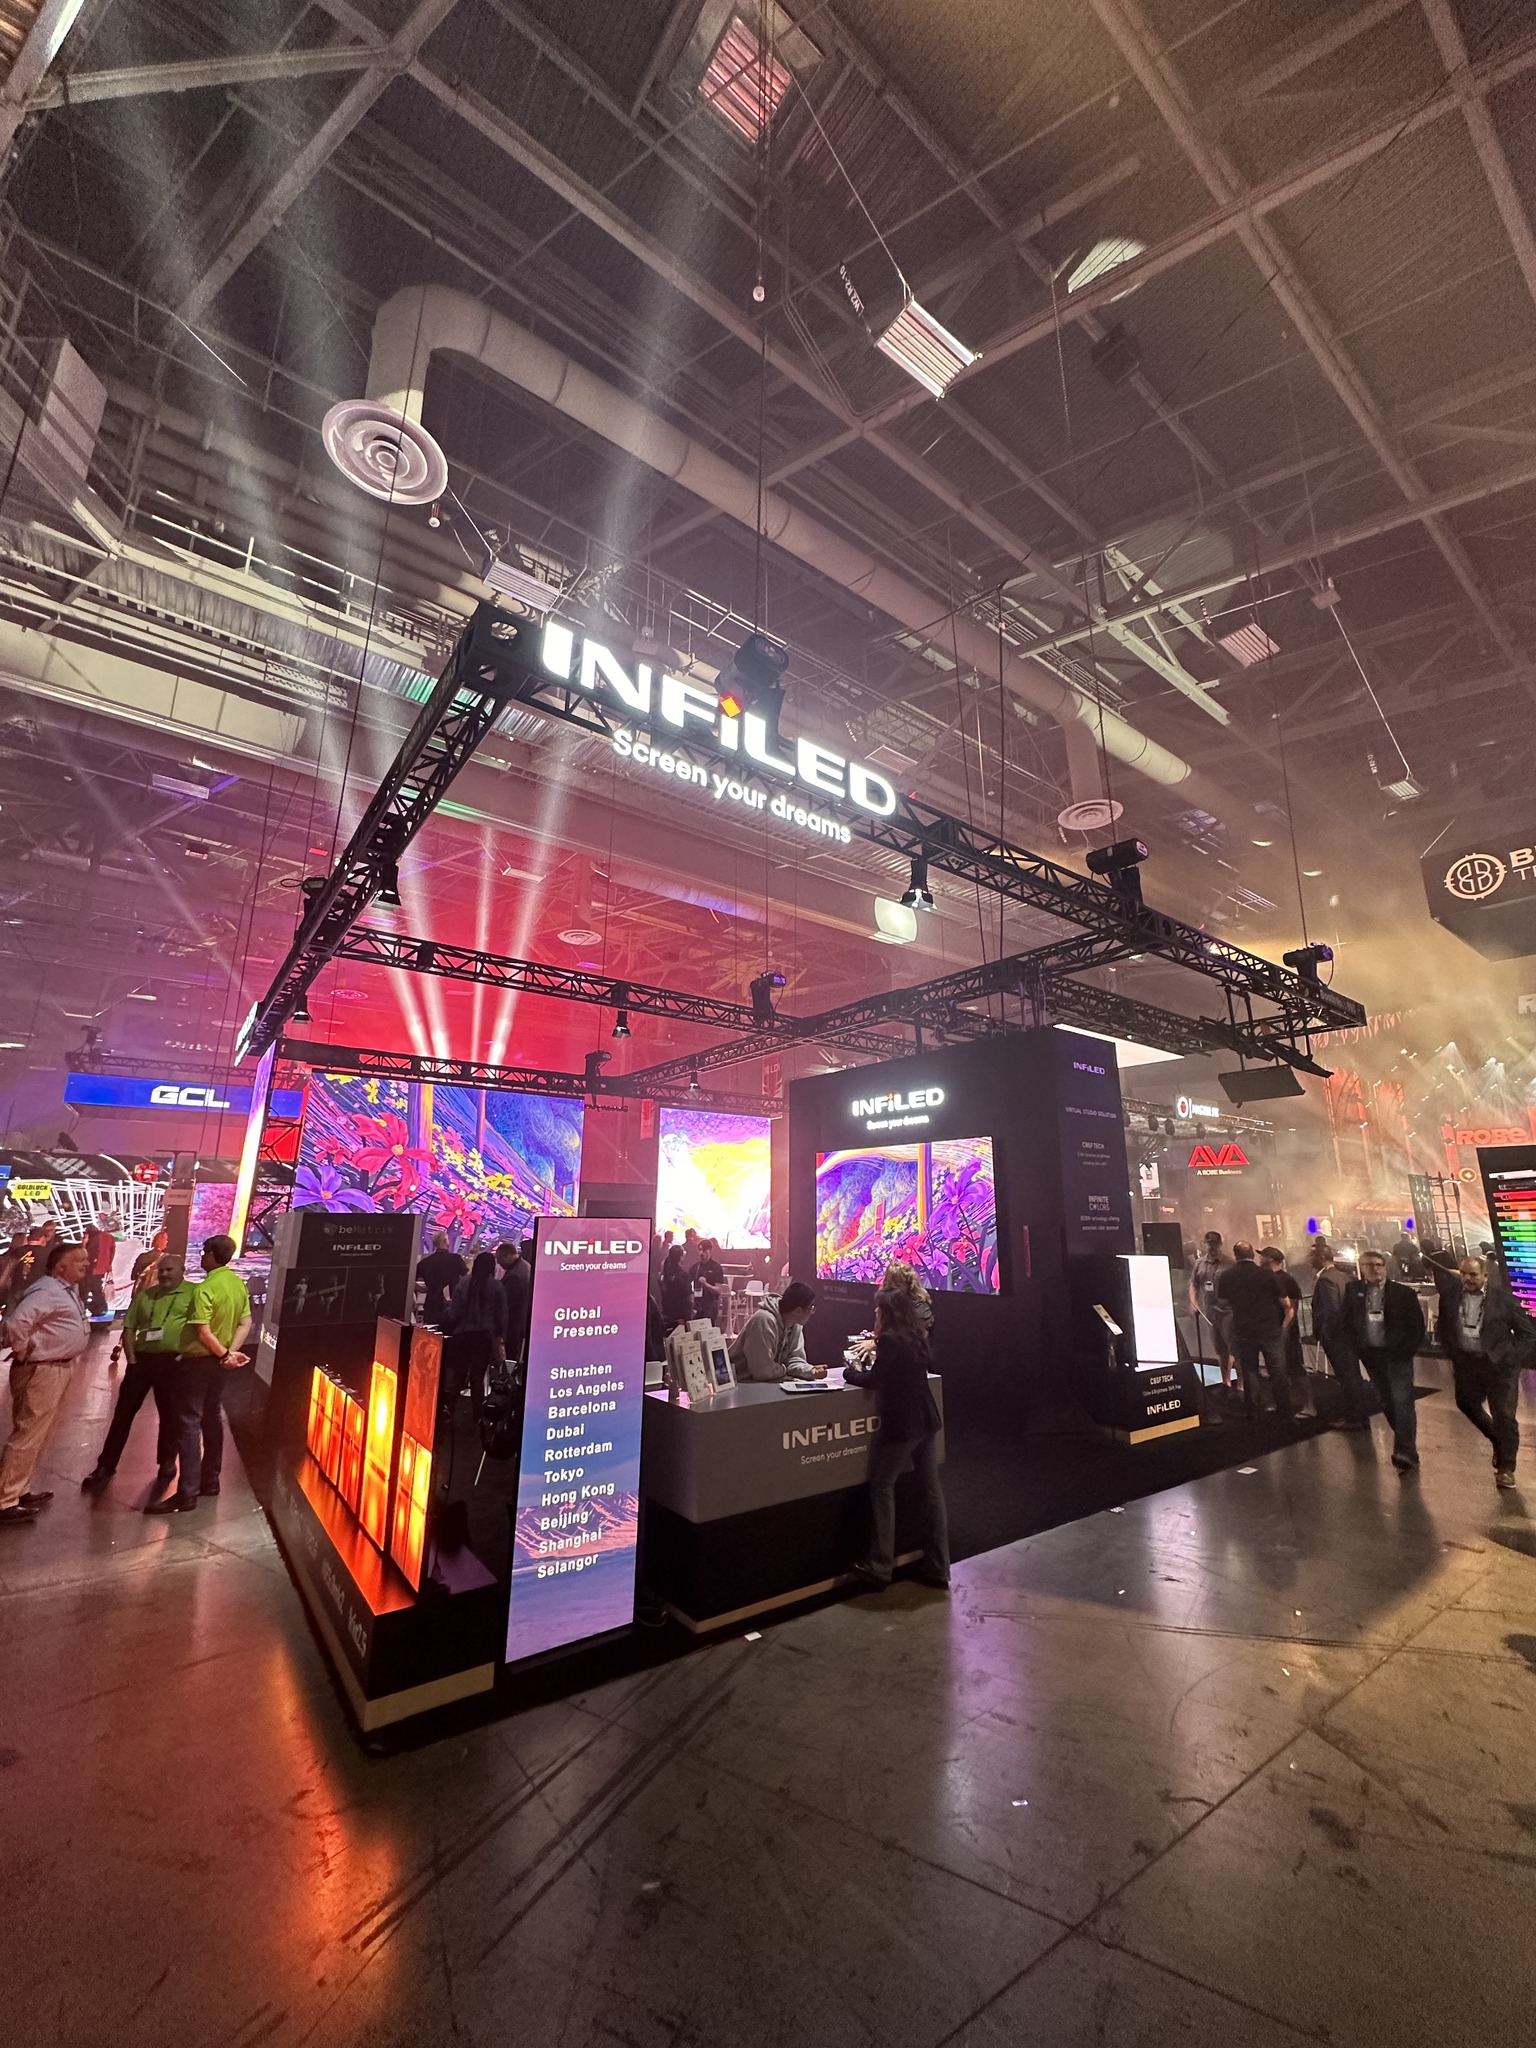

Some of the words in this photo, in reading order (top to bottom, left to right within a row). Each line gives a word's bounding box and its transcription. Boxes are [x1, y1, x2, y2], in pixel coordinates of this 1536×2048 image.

[612, 730, 708, 788] Screen
[711, 772, 768, 811] your
[771, 793, 852, 844] dreams
[150, 1085, 231, 1109] GCL
[1187, 1143, 1250, 1168] AVA
[560, 1262, 585, 1271] Screen
[585, 1263, 601, 1272] your
[602, 1261, 627, 1270] dreams
[554, 1306, 601, 1321] Global
[553, 1323, 619, 1339] Presence
[550, 1363, 613, 1380] Shenzhen
[550, 1386, 573, 1399] Los
[576, 1380, 625, 1397] Angeles
[548, 1400, 616, 1419] Barcelona
[546, 1423, 585, 1441] Dubai
[544, 1440, 613, 1462] Rotterdam
[800, 1454, 826, 1465] Screen
[826, 1450, 842, 1462] your
[842, 1444, 867, 1456] dreams
[544, 1467, 585, 1484] Tokyo
[541, 1490, 577, 1507] Hong
[581, 1482, 615, 1499] Kong
[540, 1510, 589, 1531] Beijing
[539, 1528, 602, 1554] Shanghai
[537, 1553, 599, 1579] Selangor
